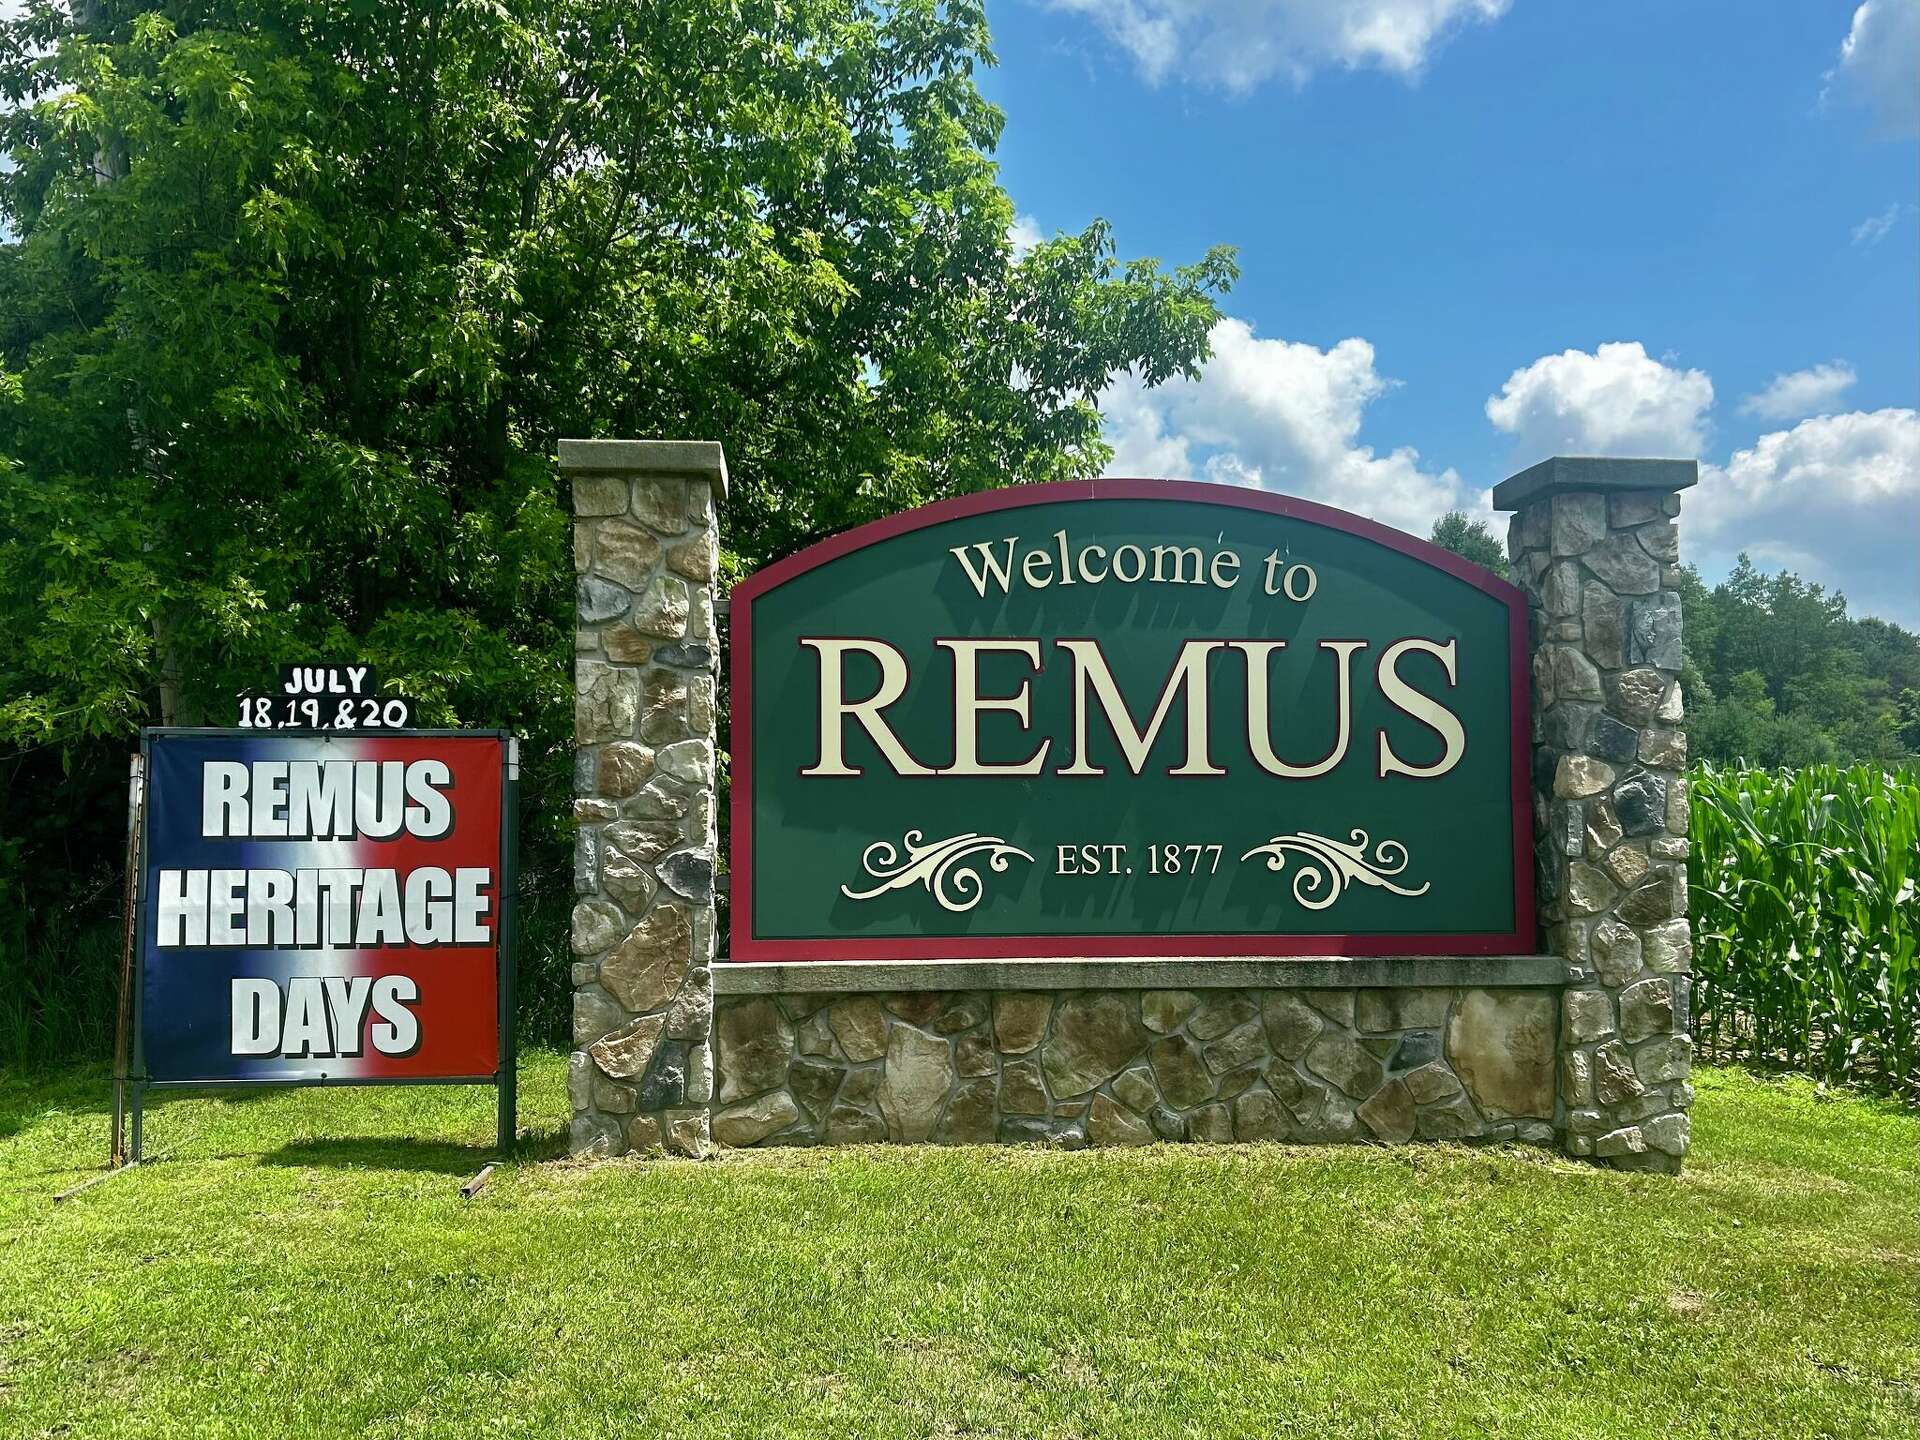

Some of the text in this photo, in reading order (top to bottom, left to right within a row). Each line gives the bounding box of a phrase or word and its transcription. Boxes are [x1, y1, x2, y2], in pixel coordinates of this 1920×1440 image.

[950, 528, 1318, 601] Welcome to
[284, 667, 367, 694] JULY
[800, 638, 1467, 778] REMUS
[202, 760, 453, 840] REMUS
[1056, 844, 1223, 876] EST. 1877
[156, 867, 492, 947] HERITAGE
[231, 976, 419, 1056] DAYS
